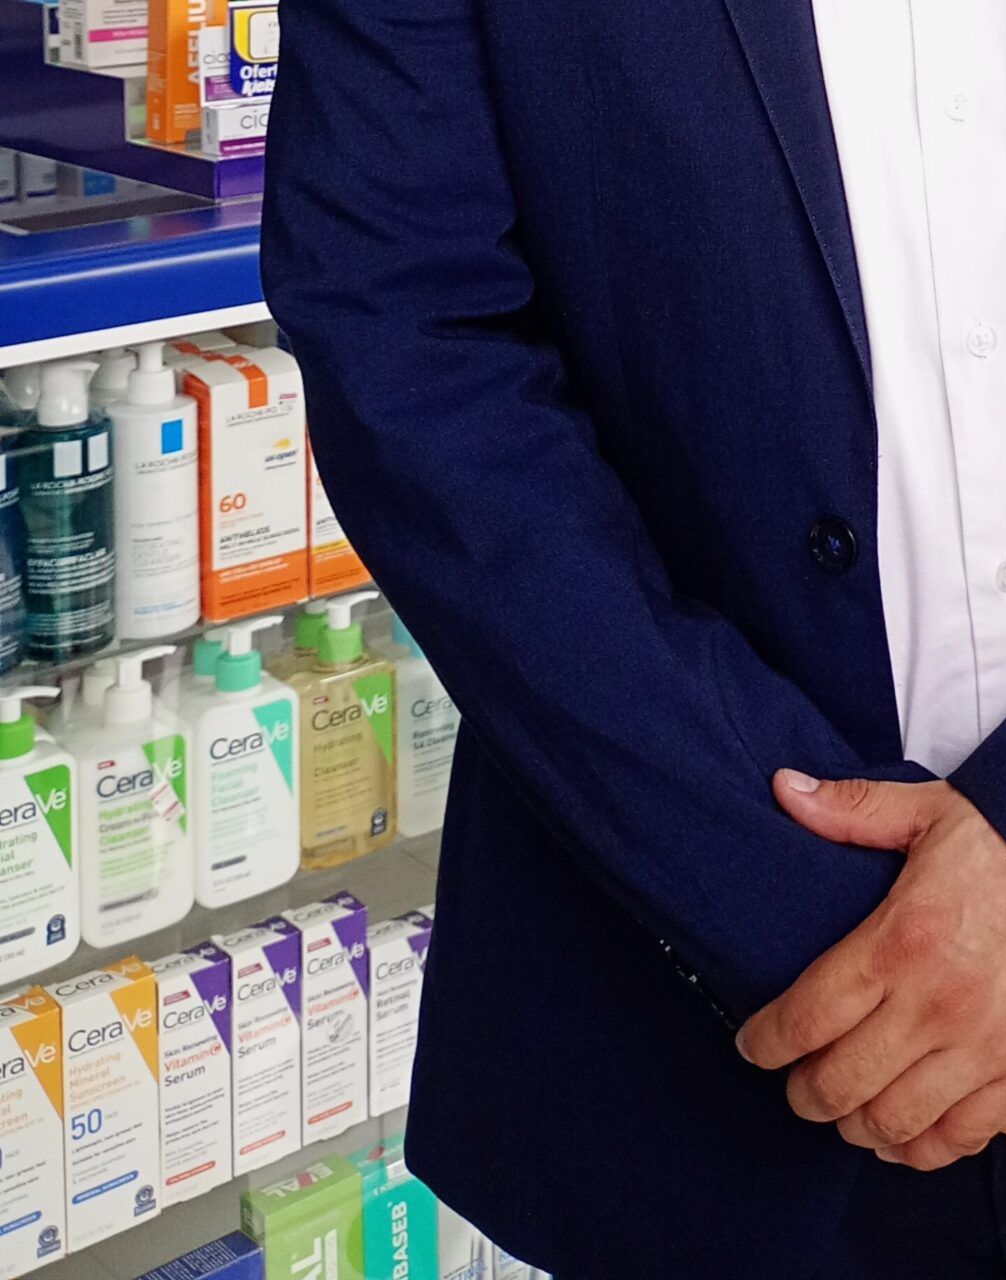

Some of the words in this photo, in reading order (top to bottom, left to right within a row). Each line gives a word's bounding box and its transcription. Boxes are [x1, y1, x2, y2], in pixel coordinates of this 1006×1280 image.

[219, 493, 247, 513] 60
[312, 692, 389, 732] CeraVe
[209, 720, 291, 762] CeraVe
[97, 753, 183, 799] CeraVe
[307, 941, 365, 976] CeraVe
[56, 961, 142, 997] CeraVe
[237, 966, 297, 1002] CeraVe
[68, 1007, 153, 1053] CeraVe
[163, 995, 227, 1030] CeraVe
[69, 1052, 122, 1076] Hydrating
[164, 1049, 210, 1072] Vitamin
[238, 1036, 277, 1059] Serum
[69, 1074, 127, 1101] Sunscreen
[164, 1064, 206, 1087] Serum
[71, 1107, 103, 1141] 50
